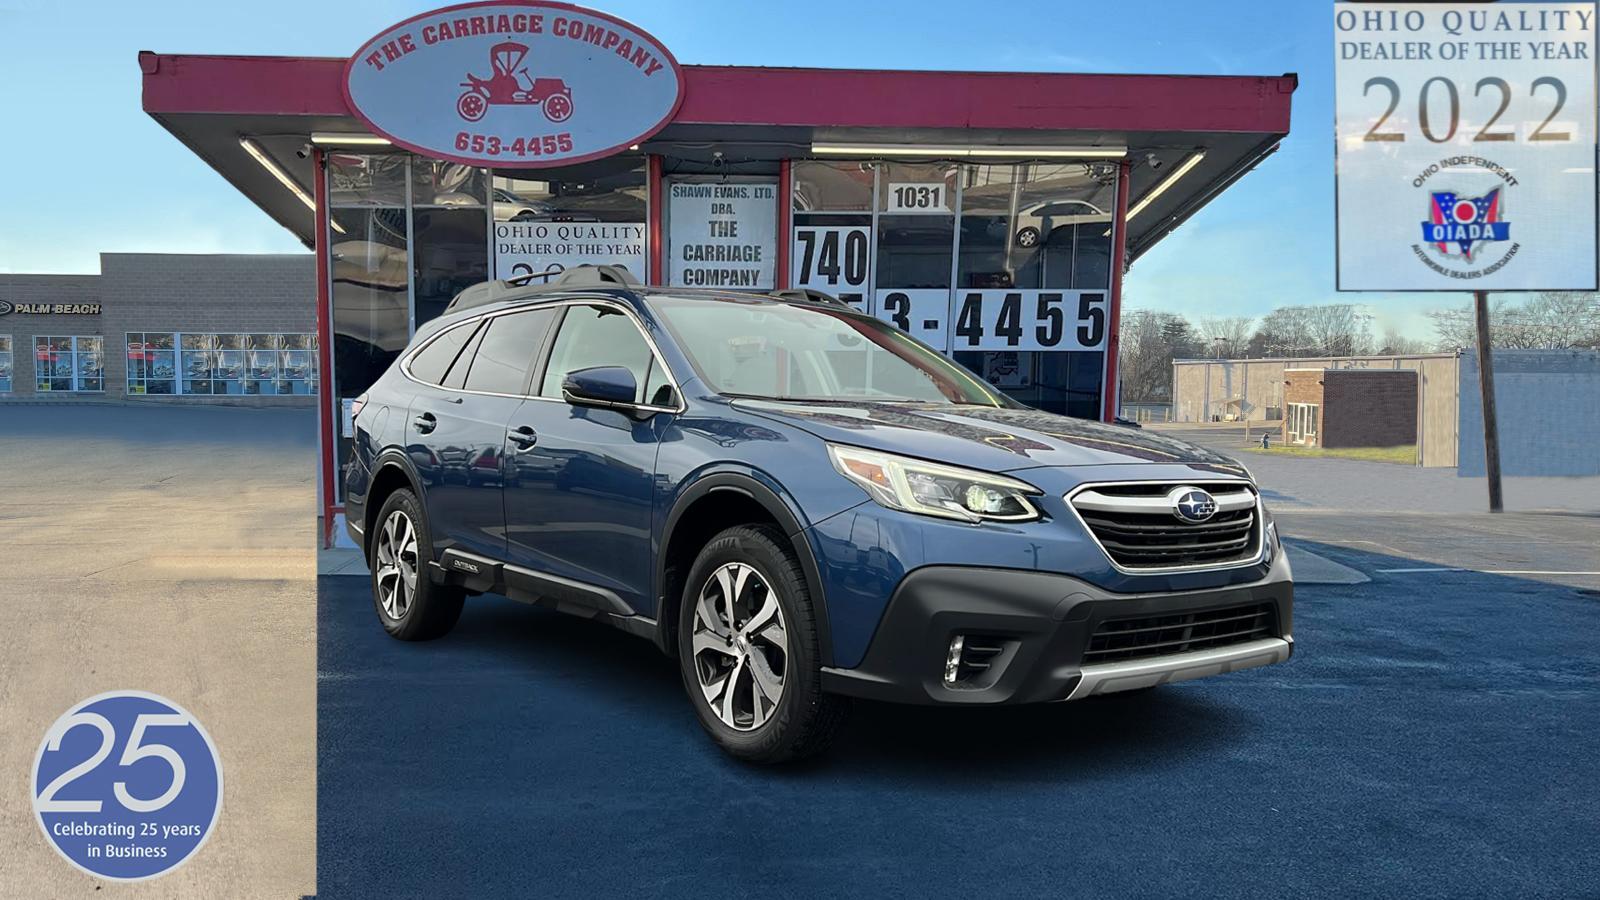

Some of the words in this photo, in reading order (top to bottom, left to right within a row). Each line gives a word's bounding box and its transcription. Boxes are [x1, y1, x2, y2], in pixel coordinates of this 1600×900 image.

[1336, 10, 1425, 31] OHIO
[1442, 10, 1593, 36] QUALITY
[366, 34, 417, 71] THE
[422, 14, 544, 46] CARRIAGE
[552, 16, 665, 77] COMPANY
[1340, 42, 1433, 60] DEALER
[1438, 42, 1469, 60] OF
[1475, 42, 1522, 60] THE
[1528, 42, 1589, 60] YEAR
[1362, 76, 1571, 144] 2022
[455, 131, 574, 157] 653-4455
[1412, 163, 1440, 188] OHIO
[1440, 155, 1520, 188] INDEPENDENT
[672, 185, 712, 199] SHAWN
[754, 186, 775, 199] LTD.
[893, 186, 941, 209] 1031
[711, 203, 736, 215] DBA.
[496, 226, 548, 239] OHIO
[557, 226, 644, 242] QUALITY
[708, 220, 738, 238] THE
[1432, 224, 1495, 240] OIADA
[499, 243, 553, 255] DEALER
[555, 243, 573, 255] OF
[576, 243, 604, 255] THE
[605, 243, 642, 255] YEAR
[682, 244, 762, 262] CARRIAGE
[798, 230, 868, 286] 740
[1411, 244, 1450, 277] AUTOMOBILE
[1449, 269, 1482, 280] DEALERS
[1483, 242, 1521, 276] ASSOCIATION
[682, 268, 761, 287] COMPANY
[14, 303, 51, 314] PALM
[54, 303, 100, 314] BEACH
